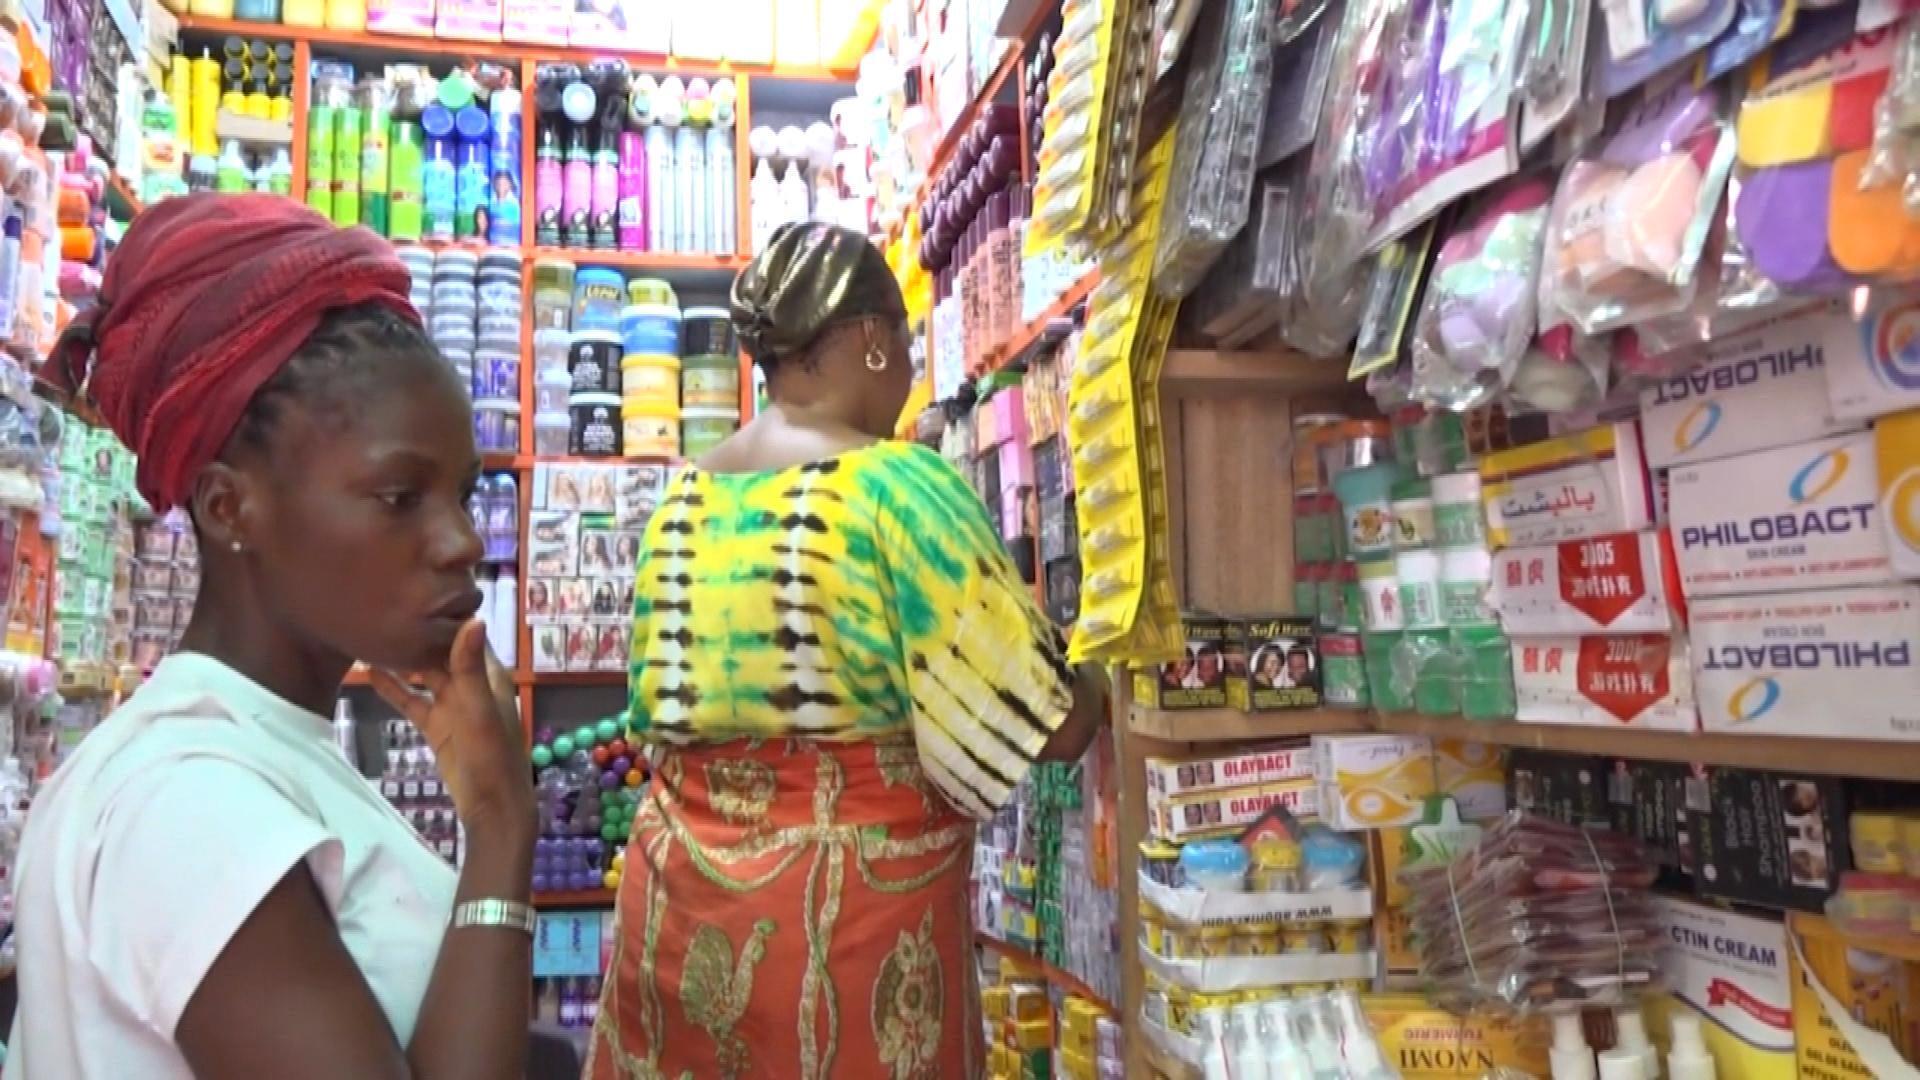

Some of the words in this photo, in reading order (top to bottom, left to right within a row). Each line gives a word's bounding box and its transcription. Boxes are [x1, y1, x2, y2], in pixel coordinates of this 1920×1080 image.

[1682, 503, 1875, 549] PHILOBACT
[1703, 642, 1910, 670] PHILOBACT
[1223, 752, 1292, 777] OLAYBACT
[1672, 925, 1709, 950] CTIN
[1713, 935, 1777, 968] CREAM
[1400, 1049, 1495, 1070] NAOMI
